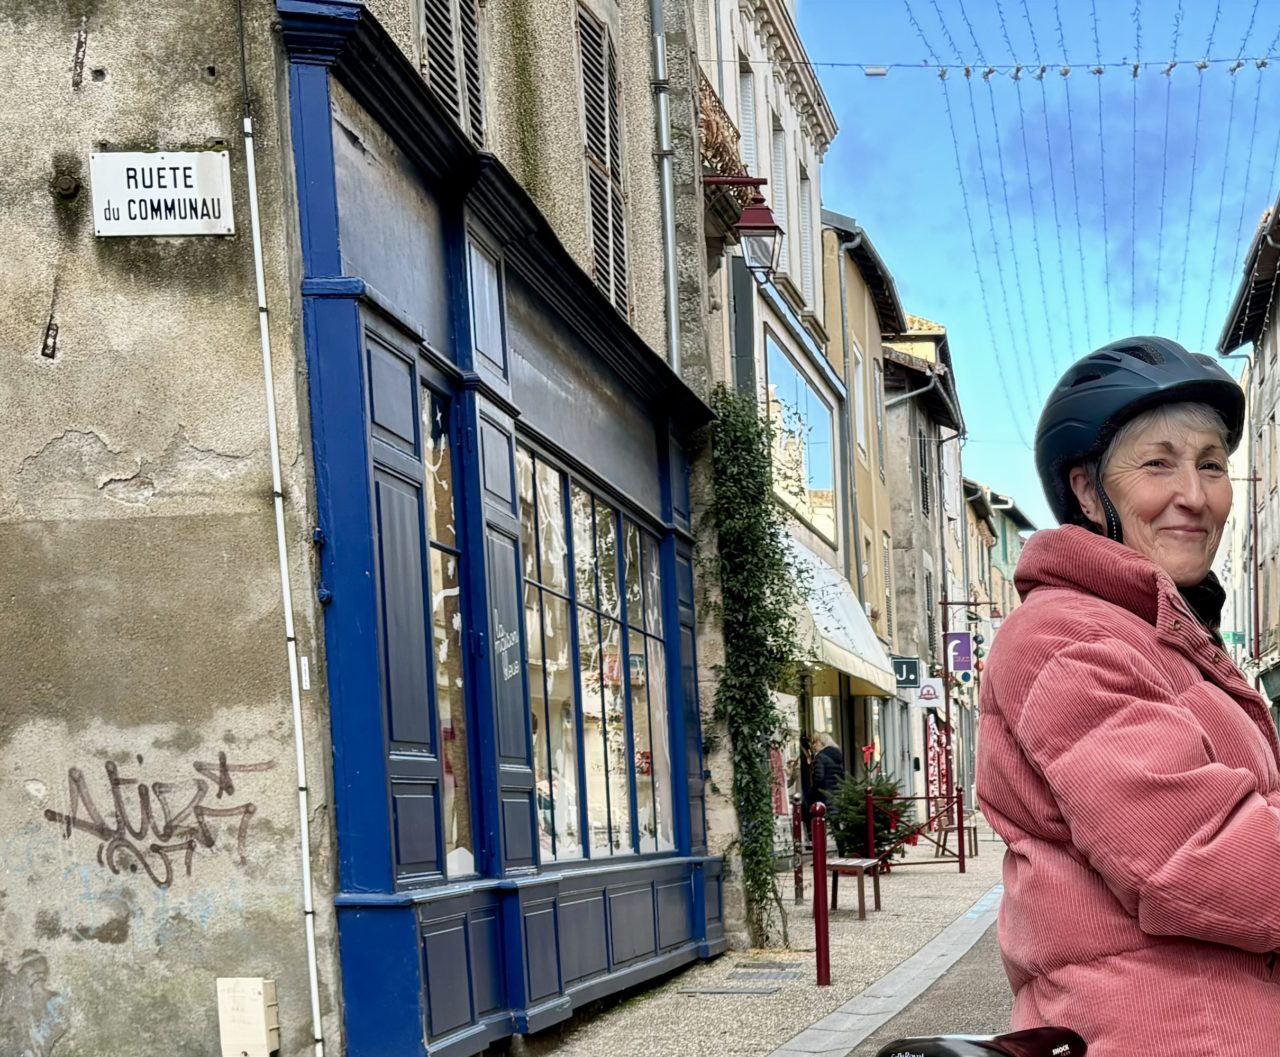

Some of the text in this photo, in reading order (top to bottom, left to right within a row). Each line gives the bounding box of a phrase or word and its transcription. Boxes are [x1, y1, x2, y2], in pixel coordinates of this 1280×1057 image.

[126, 166, 194, 189] RUETE
[104, 197, 222, 222] du COMMUNAU
